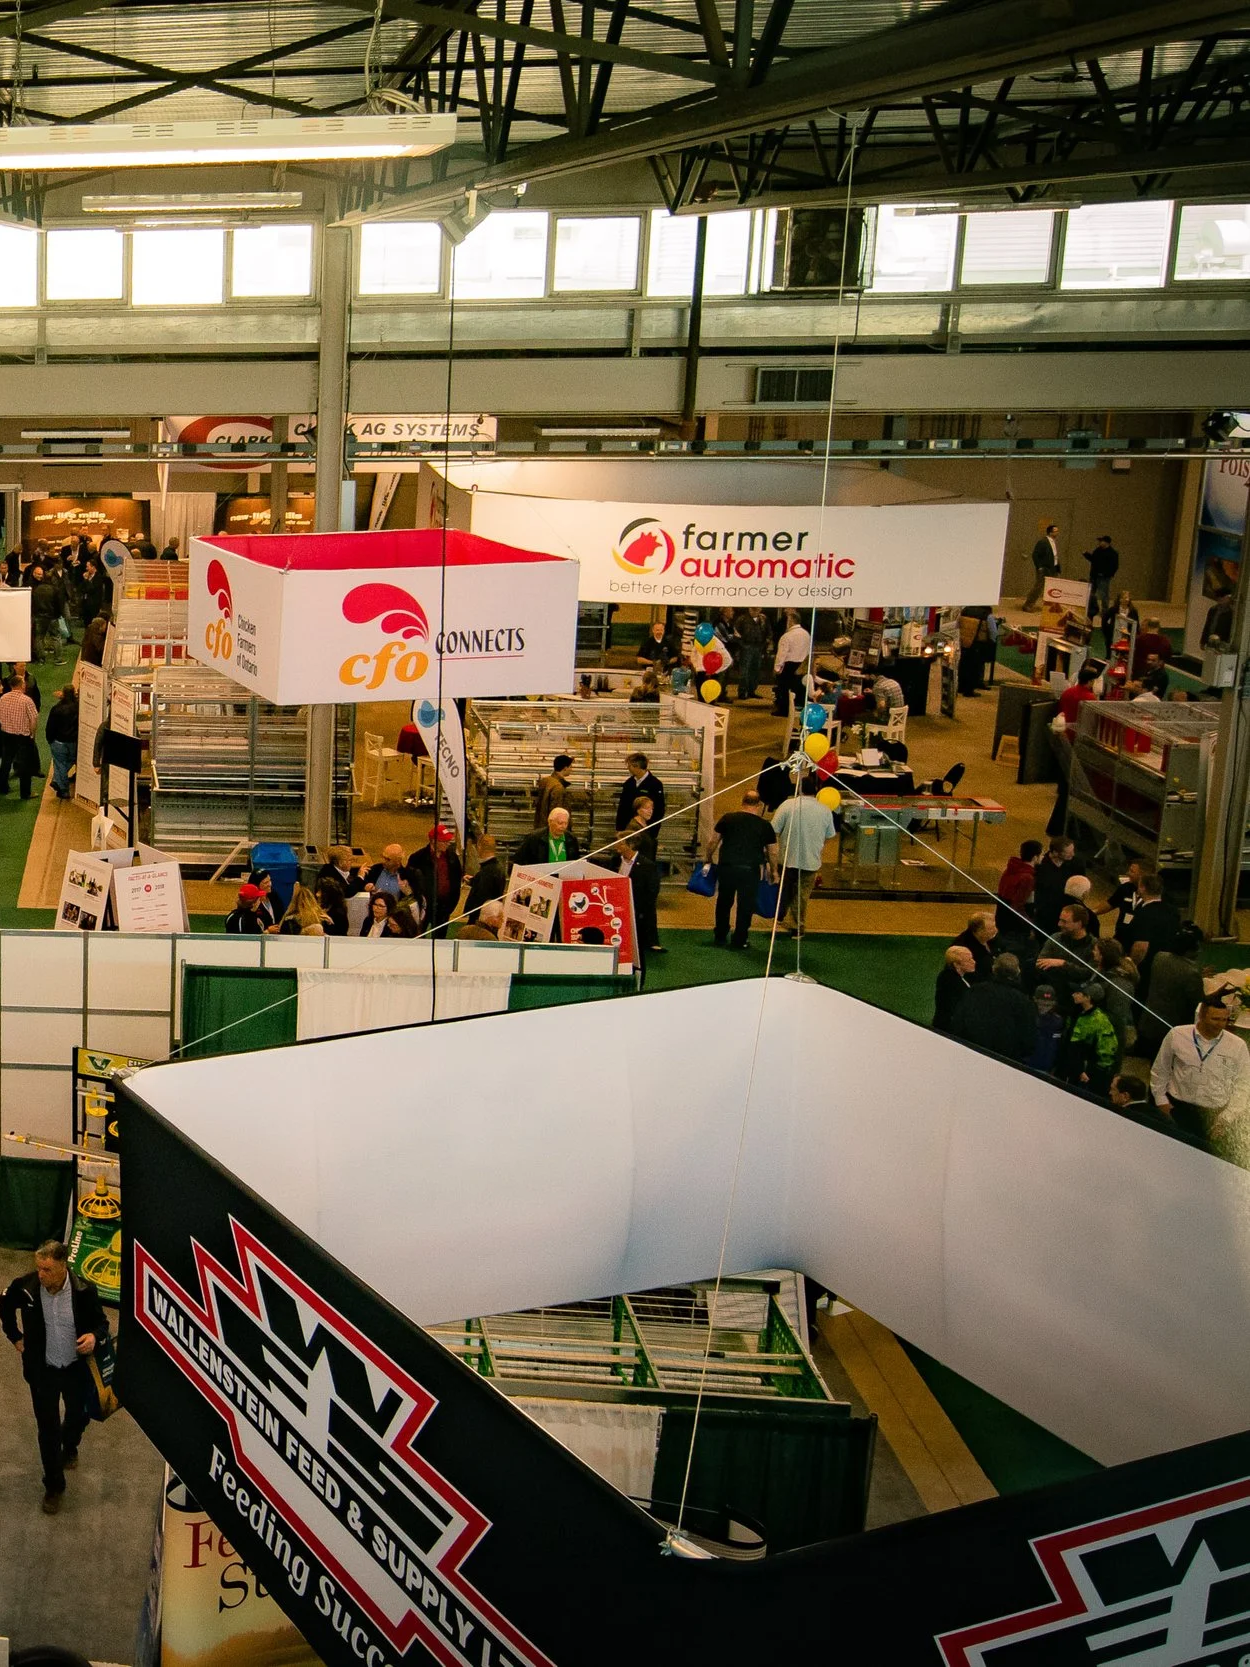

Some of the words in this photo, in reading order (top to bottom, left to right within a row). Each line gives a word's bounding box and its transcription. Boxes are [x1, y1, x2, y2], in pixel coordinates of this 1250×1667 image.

[361, 423, 386, 435] AG
[393, 423, 480, 436] SYSTEMS
[683, 524, 808, 551] farmer
[680, 553, 855, 579] automatic
[609, 579, 658, 594] better
[662, 582, 769, 597] performance
[774, 584, 793, 599] by
[798, 584, 852, 600] design
[206, 619, 232, 660] cfo
[238, 614, 256, 636] Chicken
[339, 641, 429, 690] cfo
[436, 628, 525, 654] CONNECTS
[435, 732, 459, 778] TECNO
[67, 1231, 83, 1263] ProLine
[153, 1287, 279, 1446] WALLENSTEIN
[286, 1430, 341, 1508] FEED
[347, 1500, 364, 1539] &
[372, 1525, 474, 1648] SUPPLY
[209, 1444, 310, 1597] Feeding
